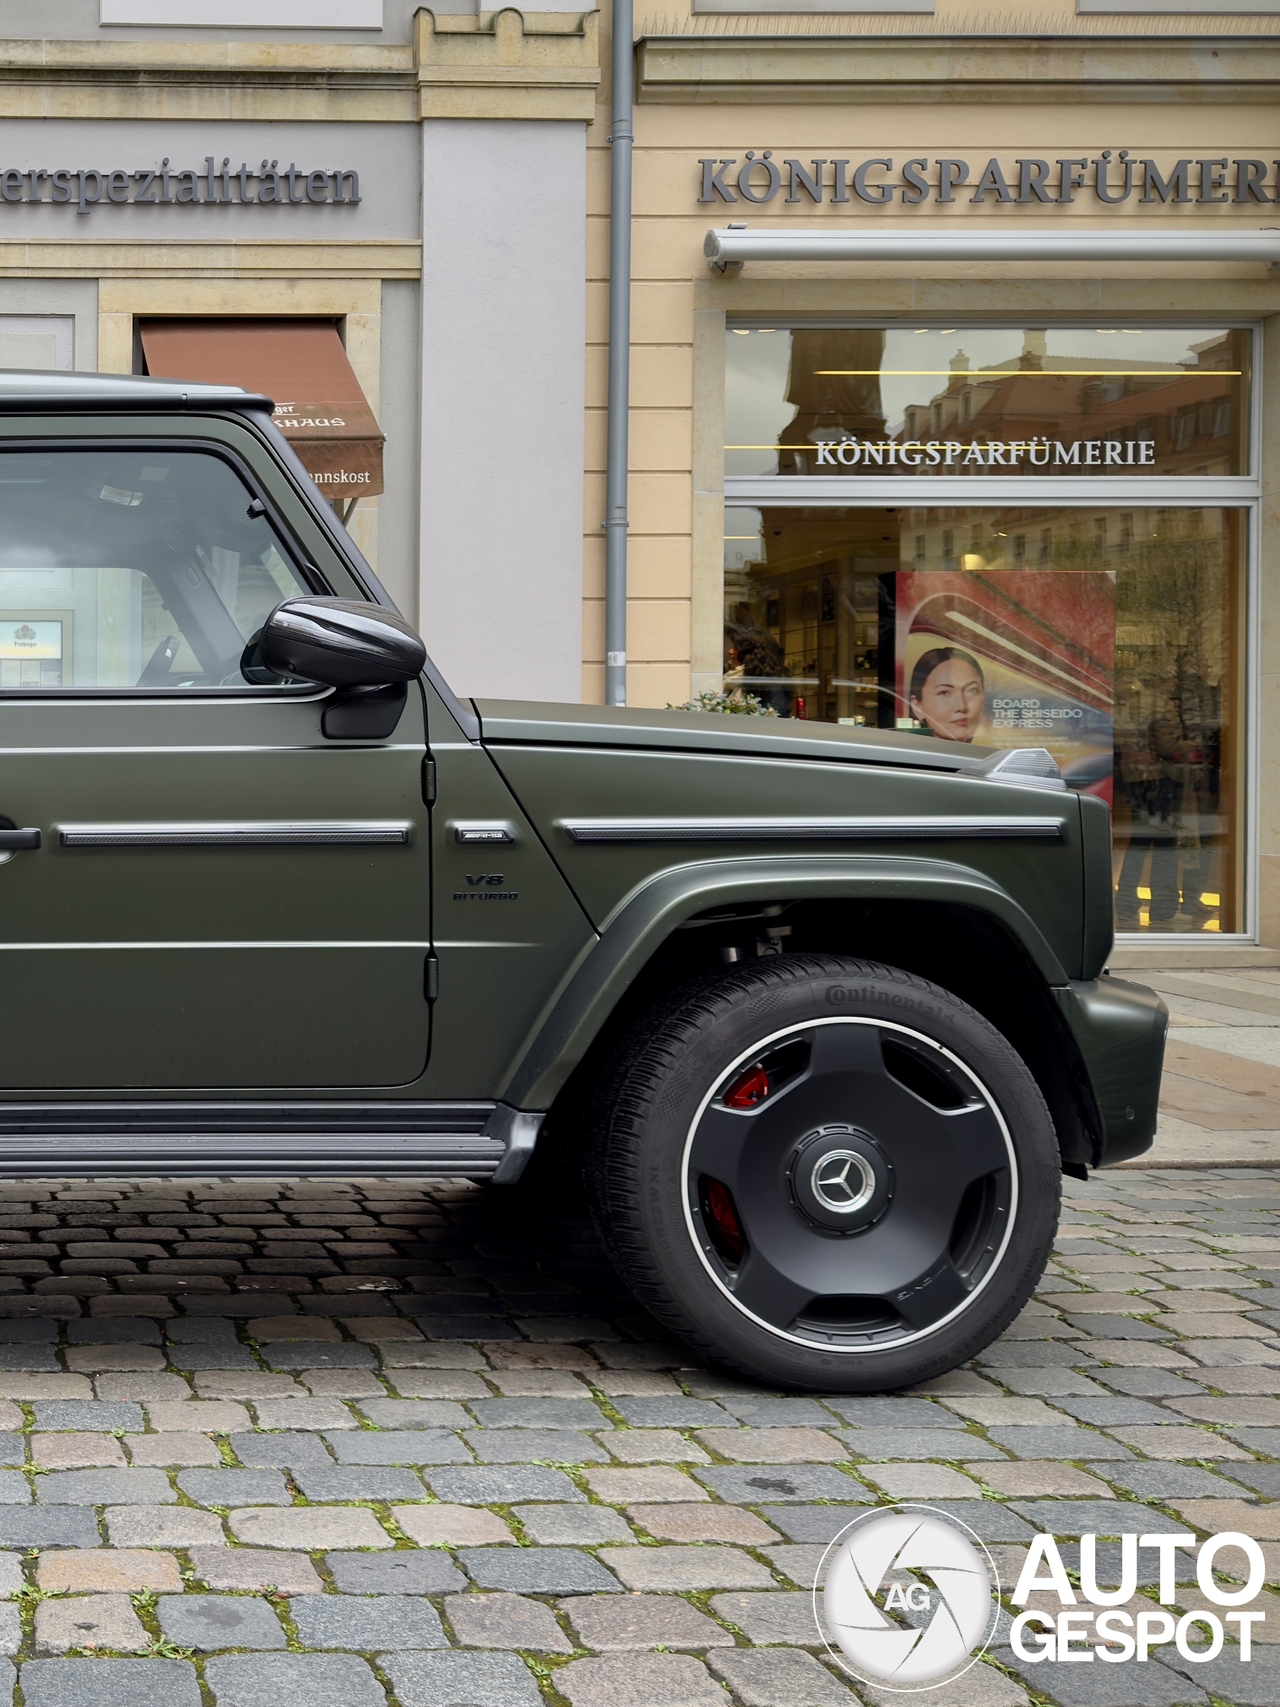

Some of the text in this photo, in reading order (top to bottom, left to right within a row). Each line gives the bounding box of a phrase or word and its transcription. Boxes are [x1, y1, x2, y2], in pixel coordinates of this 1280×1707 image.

[815, 436, 1156, 467] KÖNIGSPARFÜMERIE
[993, 699, 1040, 708] BOARD
[992, 709, 1082, 719] THE SHISEIDO
[993, 719, 1053, 728] EXPRESS
[466, 873, 504, 886] V8
[452, 891, 519, 901] BITURBO
[824, 984, 943, 1017] Continental
